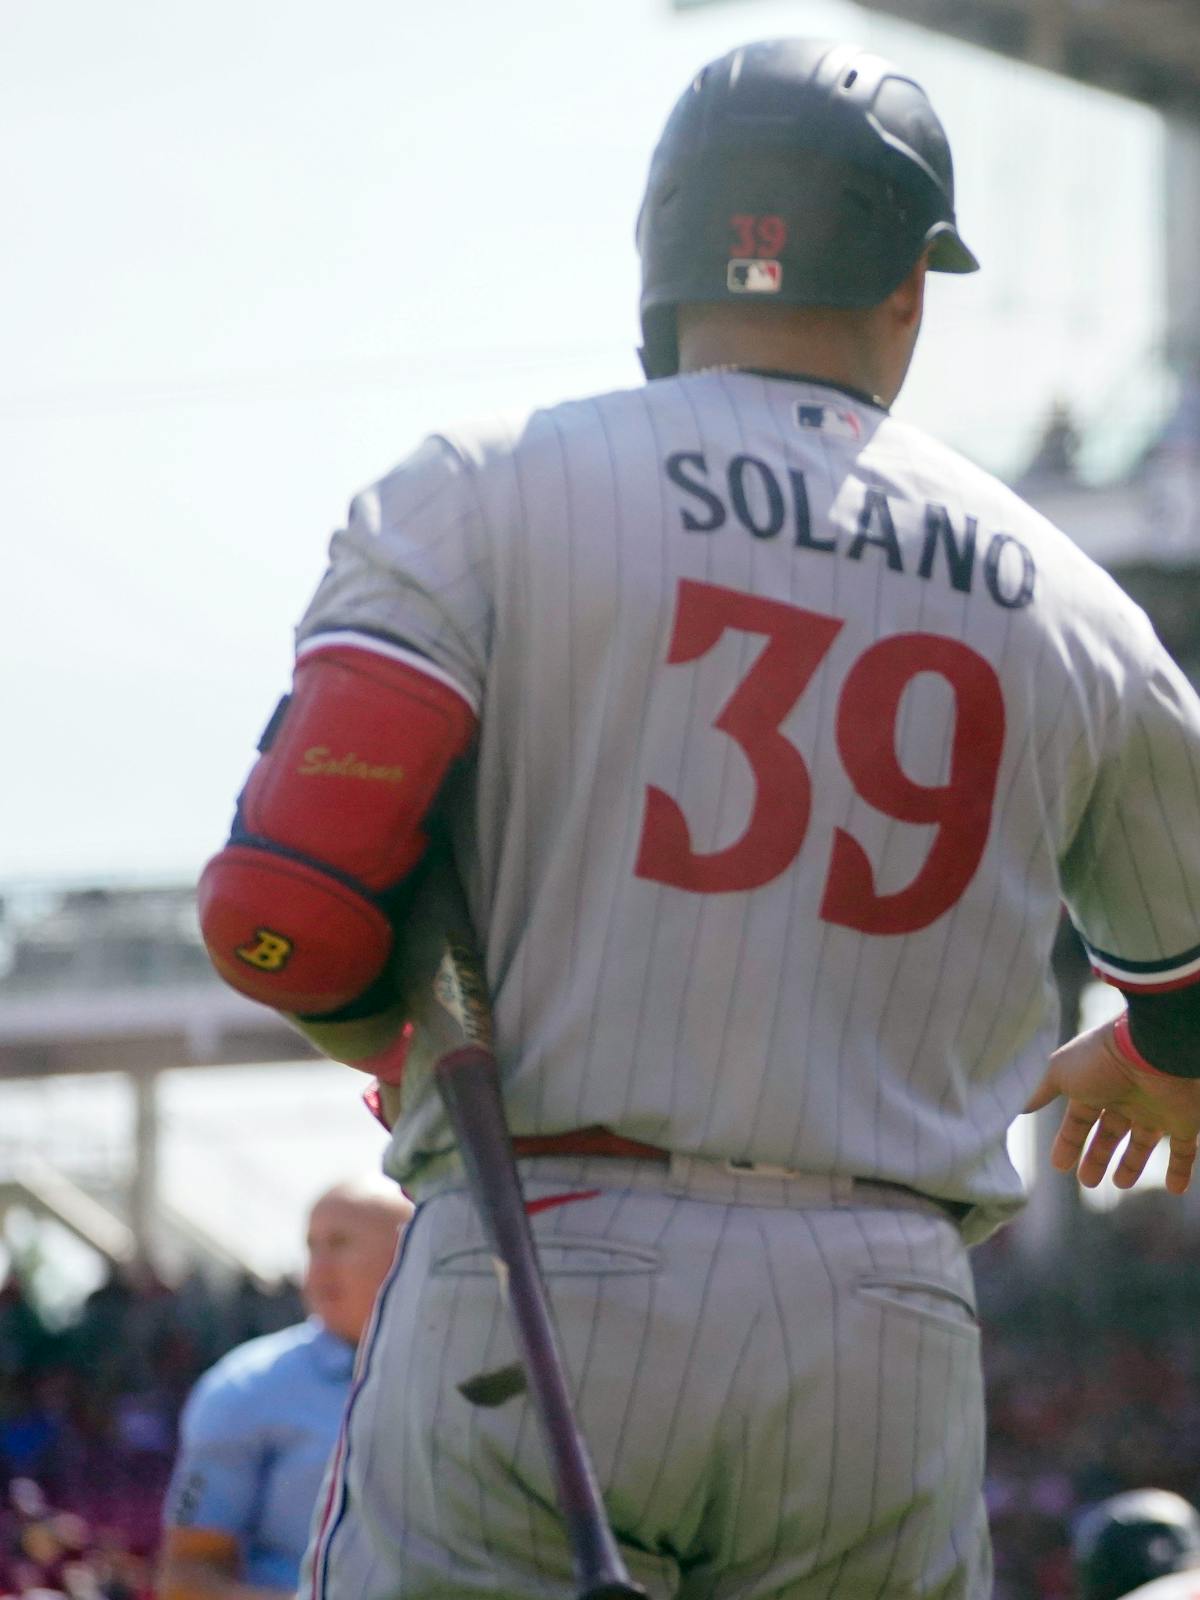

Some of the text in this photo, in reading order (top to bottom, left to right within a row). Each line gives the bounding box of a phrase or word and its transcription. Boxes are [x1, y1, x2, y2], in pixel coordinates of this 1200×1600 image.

[728, 214, 788, 258] 39
[665, 449, 1036, 609] SOLANO
[634, 577, 1006, 935] 39
